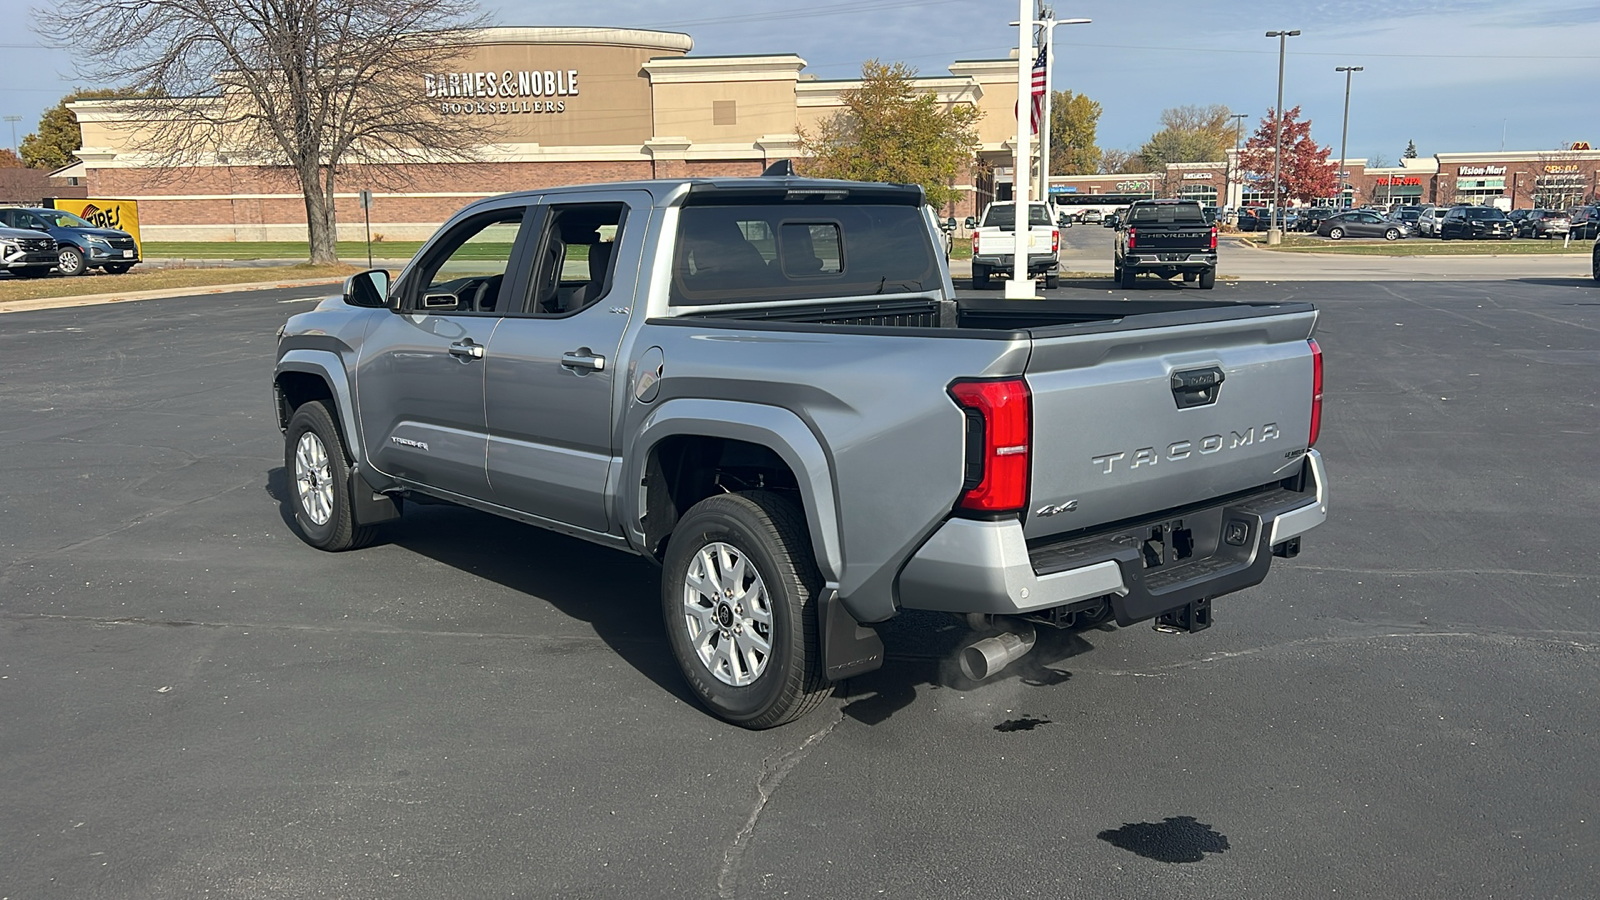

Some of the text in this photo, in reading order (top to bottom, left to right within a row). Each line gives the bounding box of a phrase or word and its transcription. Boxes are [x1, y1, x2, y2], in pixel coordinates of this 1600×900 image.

[441, 100, 566, 115] BOOKSELLERS
[1459, 165, 1507, 176] Vision Mart
[1115, 181, 1150, 191] cricket
[1403, 177, 1422, 185] SPA
[86, 205, 120, 228] TIRES
[1092, 422, 1280, 475] TACOMA
[1036, 499, 1078, 518] 4x4
